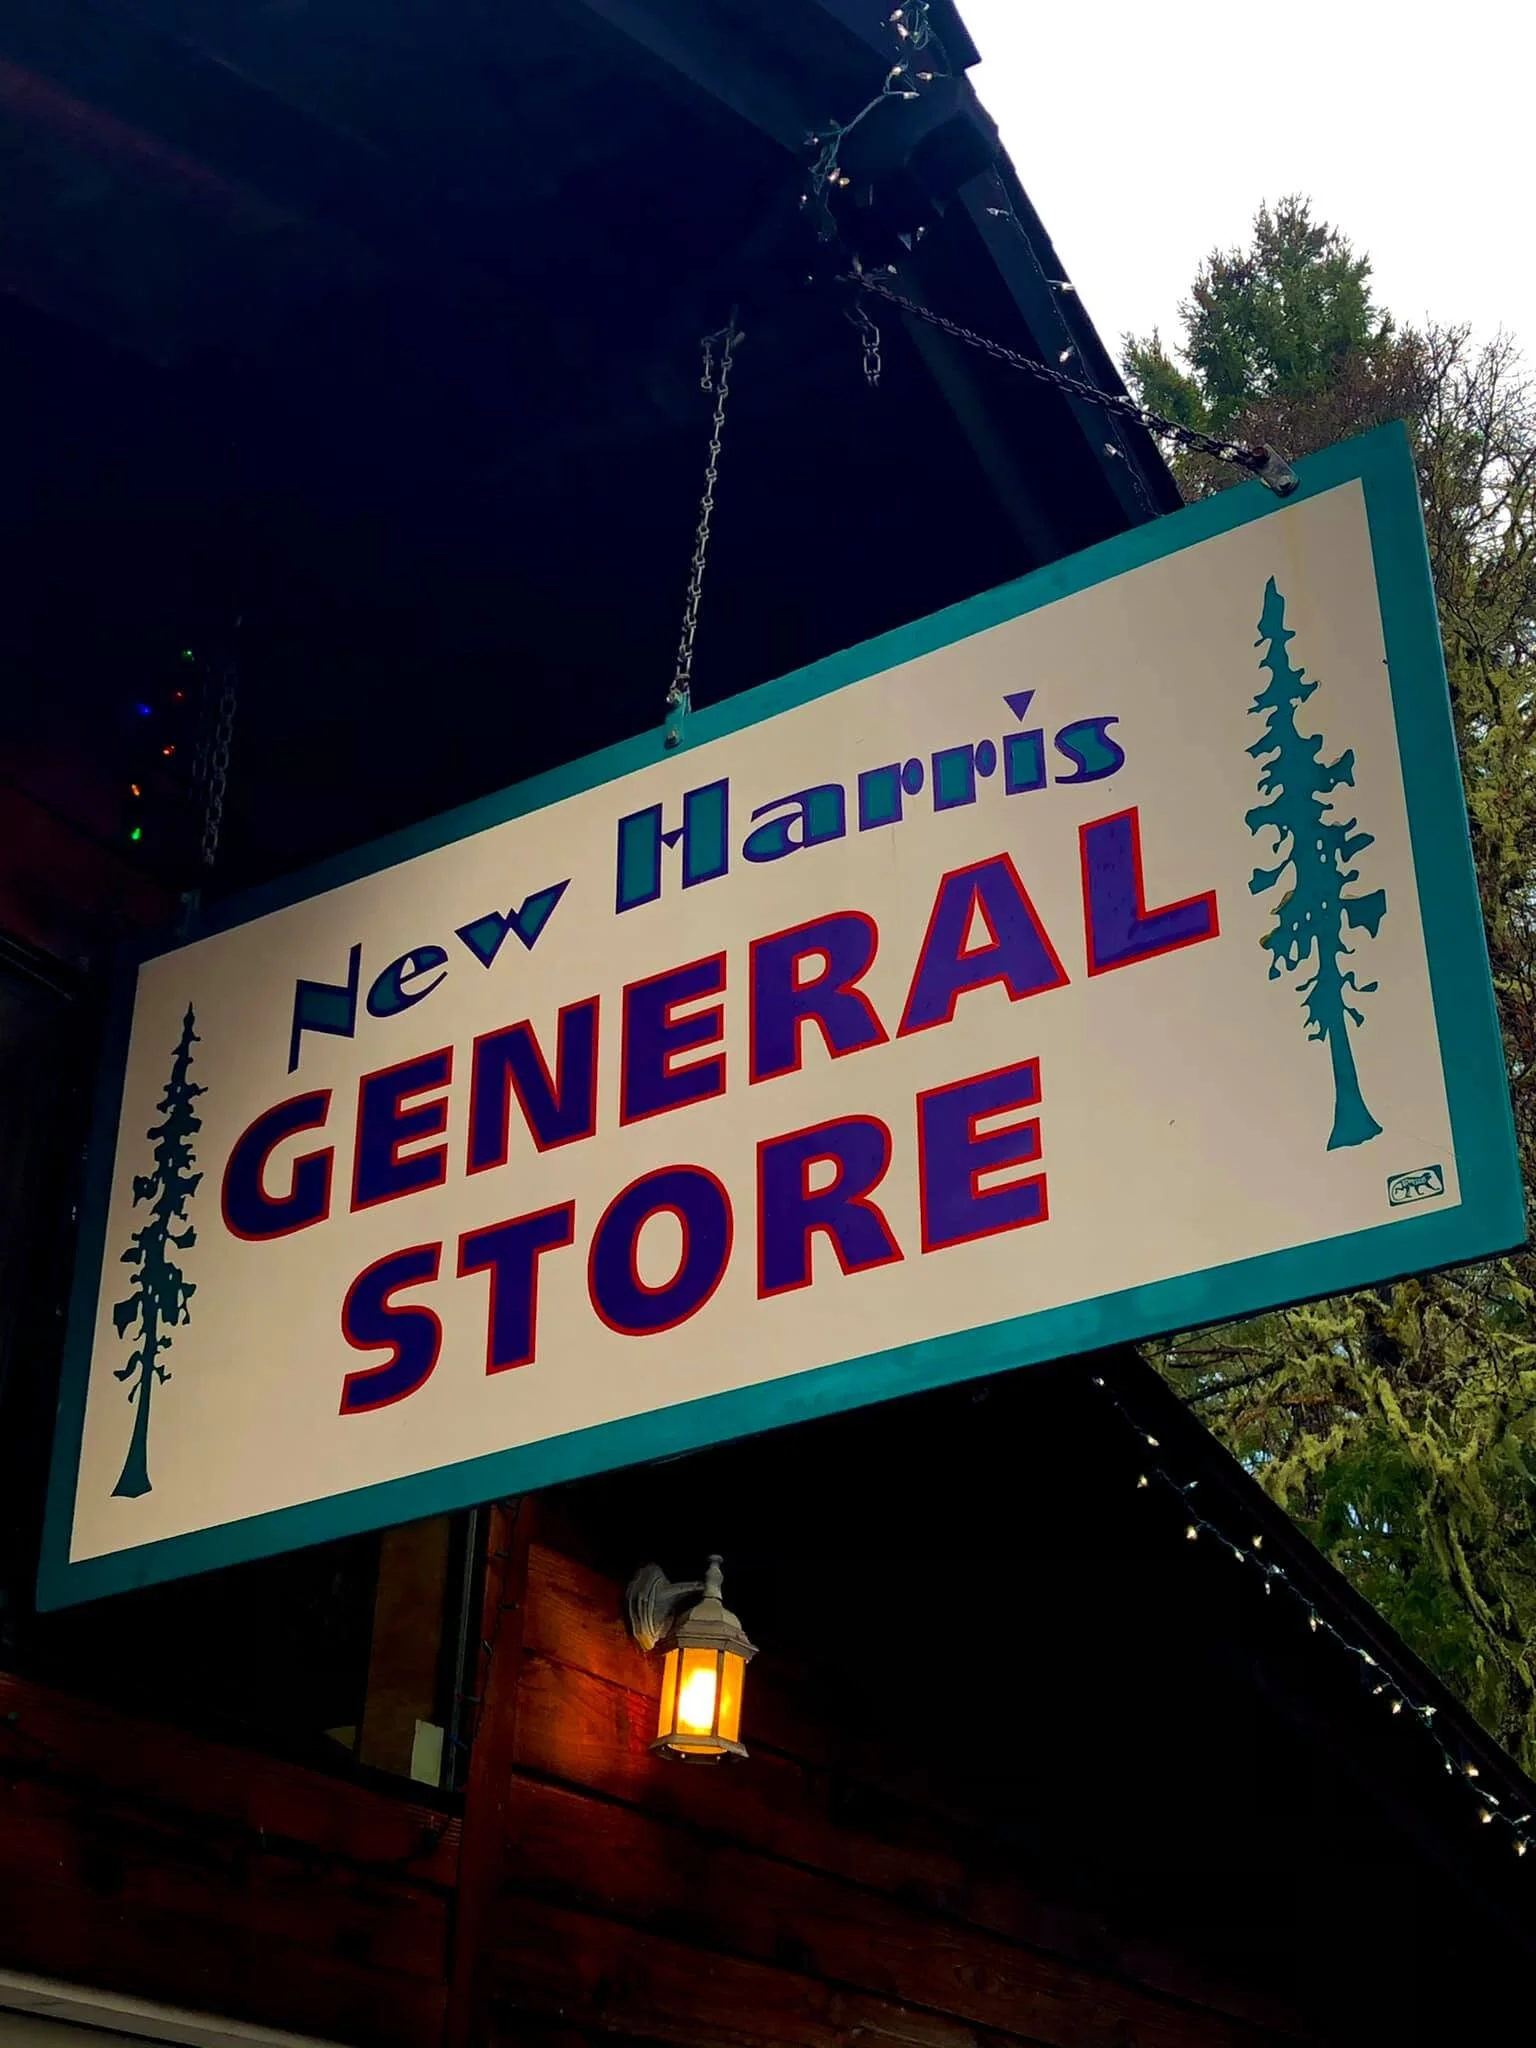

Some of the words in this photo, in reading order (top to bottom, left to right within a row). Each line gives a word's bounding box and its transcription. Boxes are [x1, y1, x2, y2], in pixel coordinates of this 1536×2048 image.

[221, 806, 1219, 1241] GENERAL
[288, 879, 571, 1073] New
[616, 689, 1125, 914] Harris
[338, 1056, 1050, 1416] STORE
